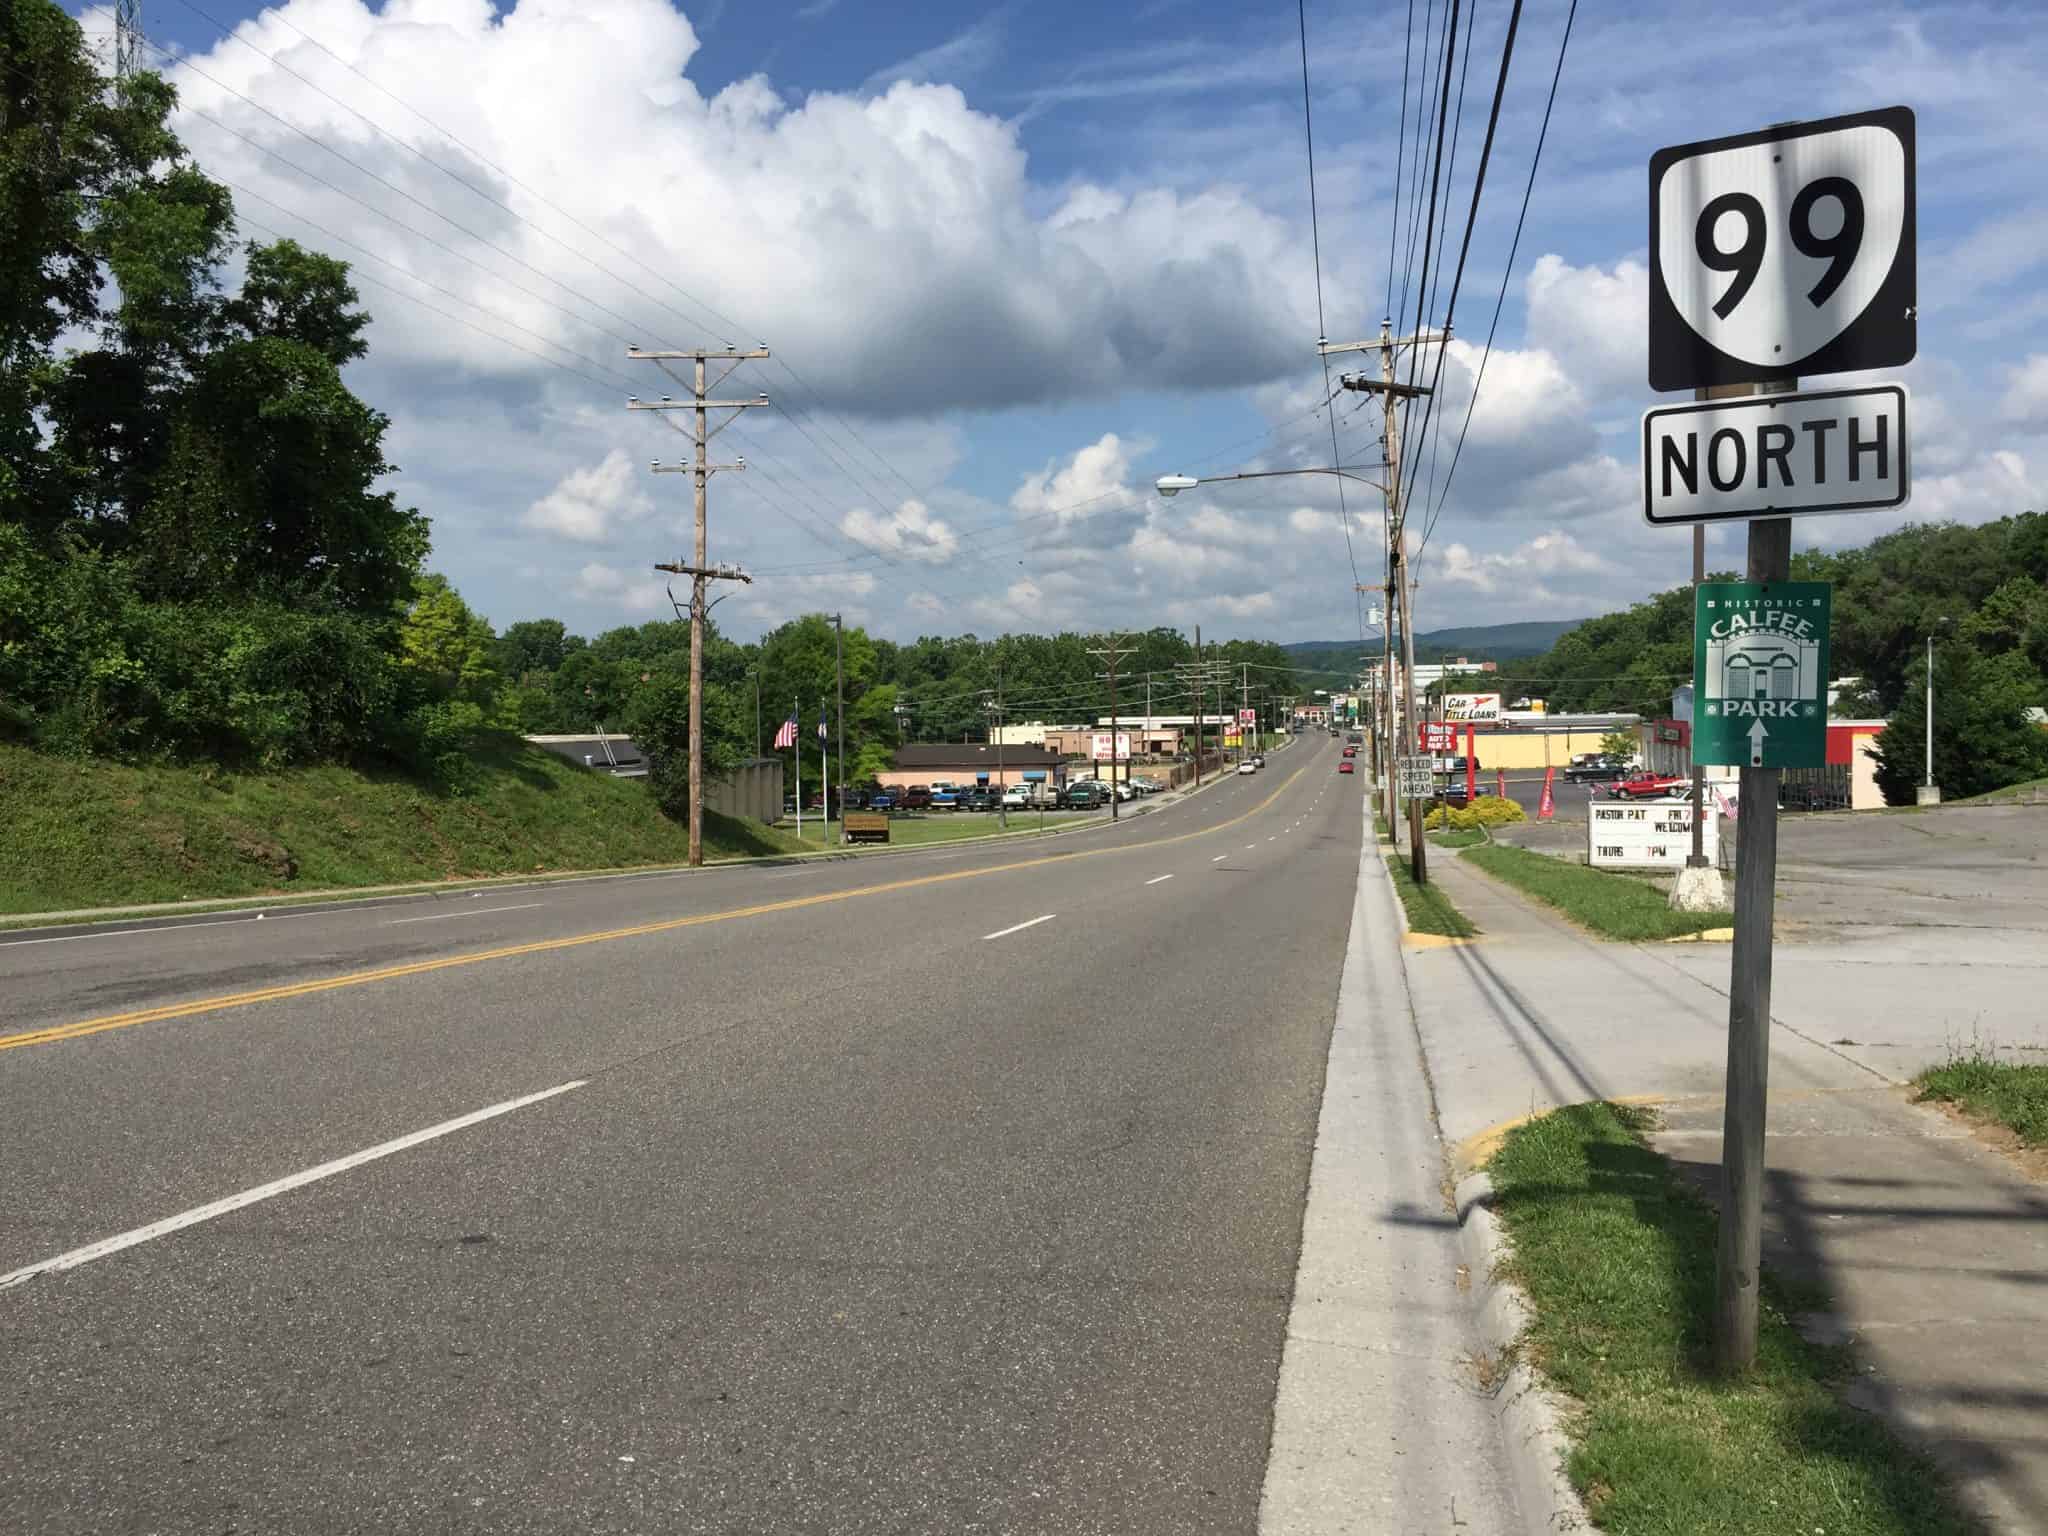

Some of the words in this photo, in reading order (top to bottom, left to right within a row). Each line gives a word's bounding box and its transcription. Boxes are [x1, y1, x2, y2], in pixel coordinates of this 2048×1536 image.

[1695, 176, 1865, 320] 99
[1661, 414, 1889, 497] NORTH
[1724, 600, 1804, 608] HISTORIC
[1710, 610, 1814, 639] CALFEE
[1448, 697, 1467, 709] CAR
[1722, 700, 1799, 717] PARK
[1402, 771, 1430, 782] SPEED
[1402, 783, 1431, 794] AHEAD
[1627, 809, 1647, 820] PAT
[1654, 822, 1695, 833] WELCOM
